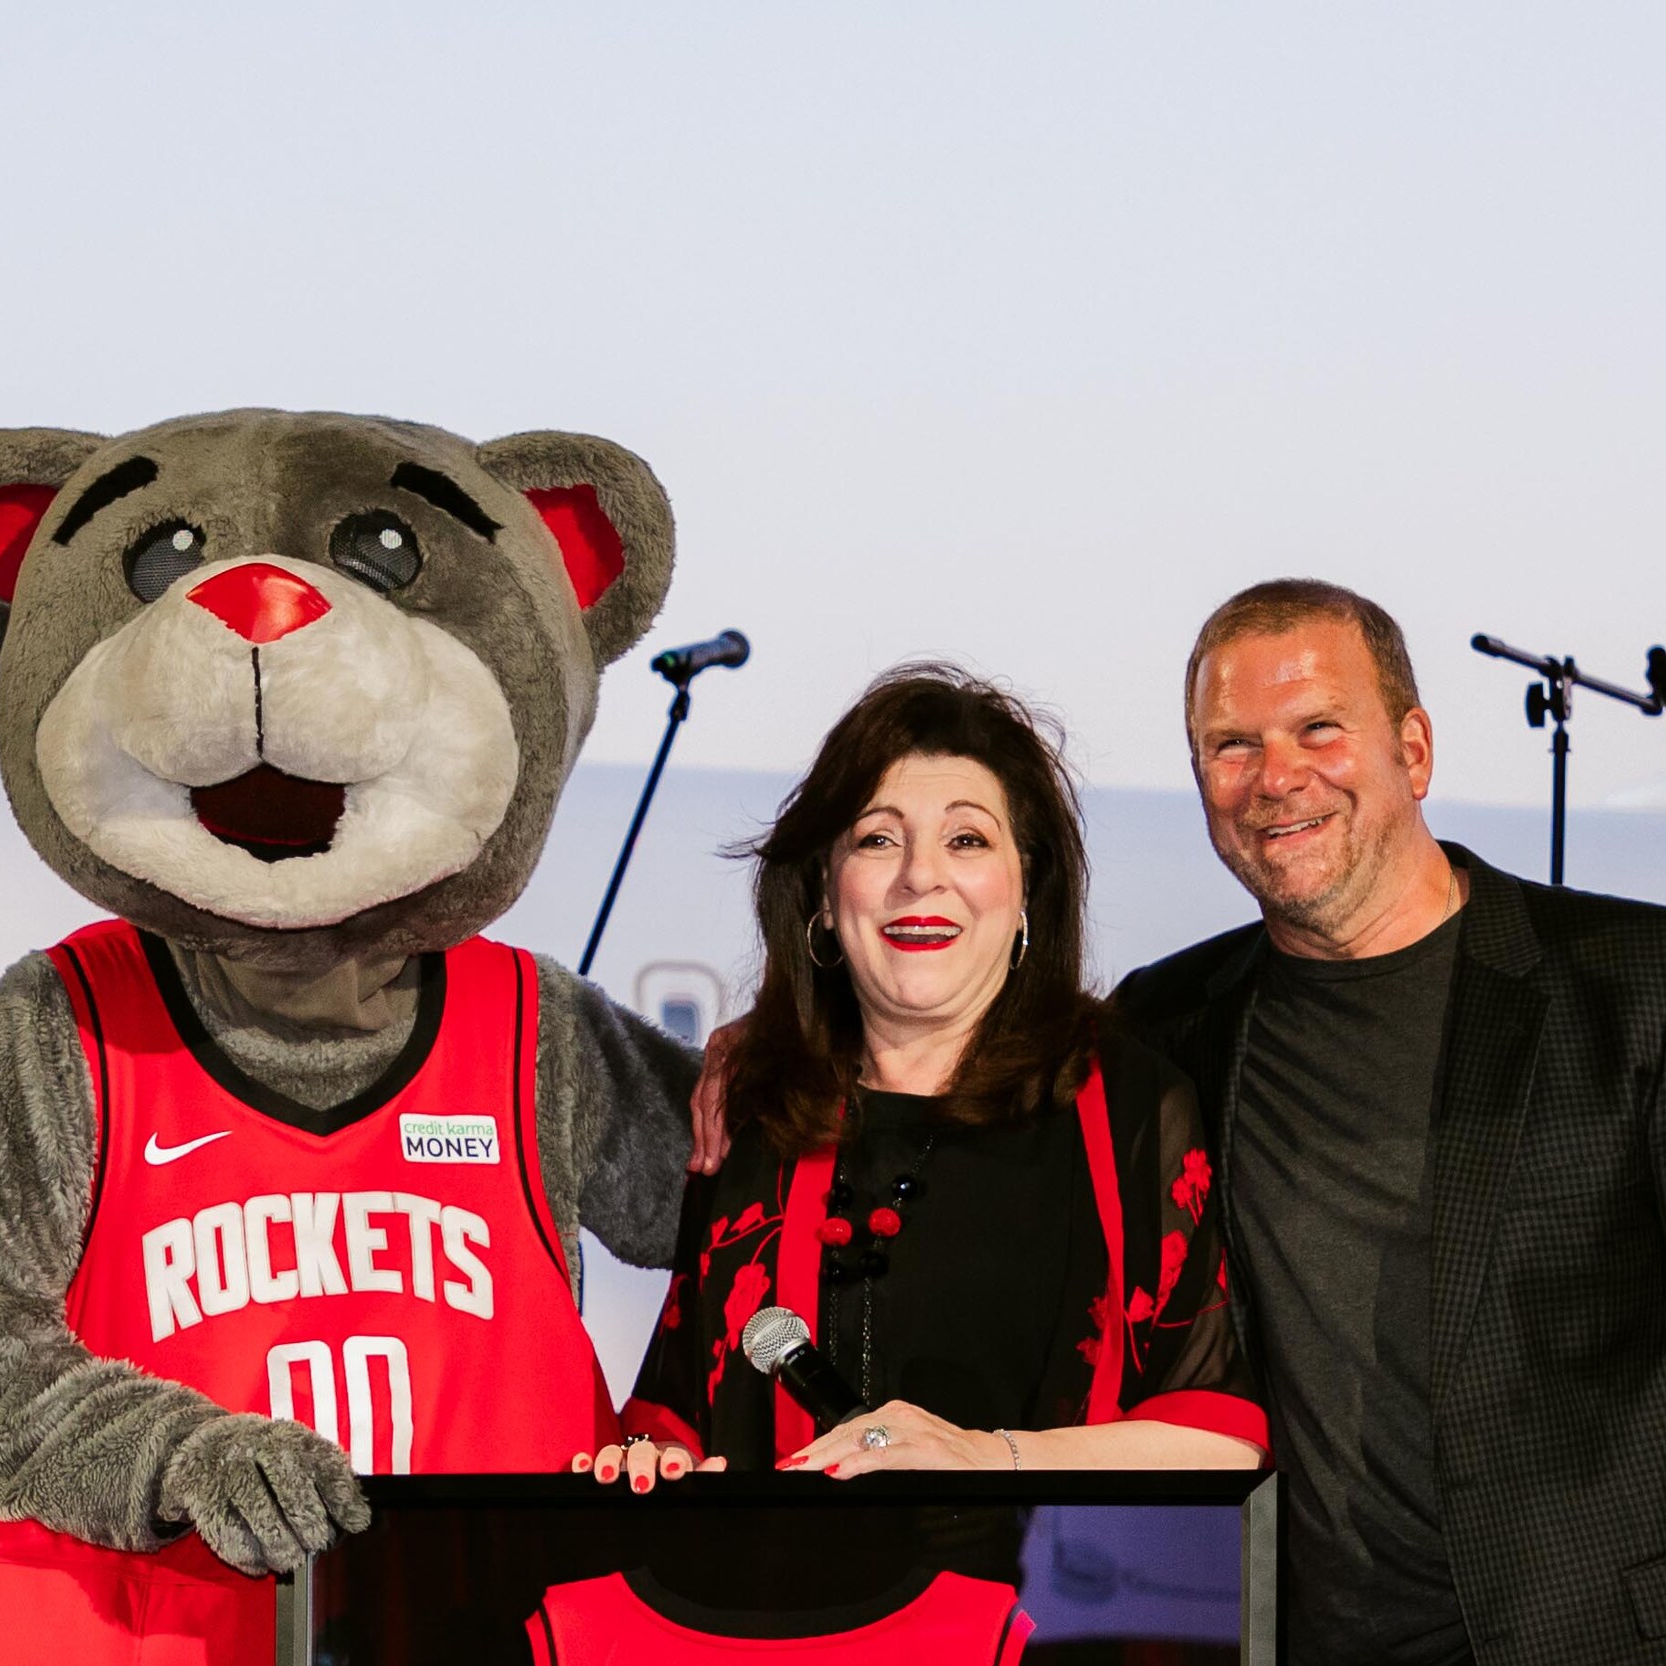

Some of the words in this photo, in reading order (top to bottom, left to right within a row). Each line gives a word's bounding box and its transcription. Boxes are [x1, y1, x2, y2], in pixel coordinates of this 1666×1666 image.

[404, 1121, 443, 1135] credit
[446, 1121, 494, 1135] karma
[406, 1136, 493, 1158] MONEY
[142, 1191, 494, 1343] ROCKETS
